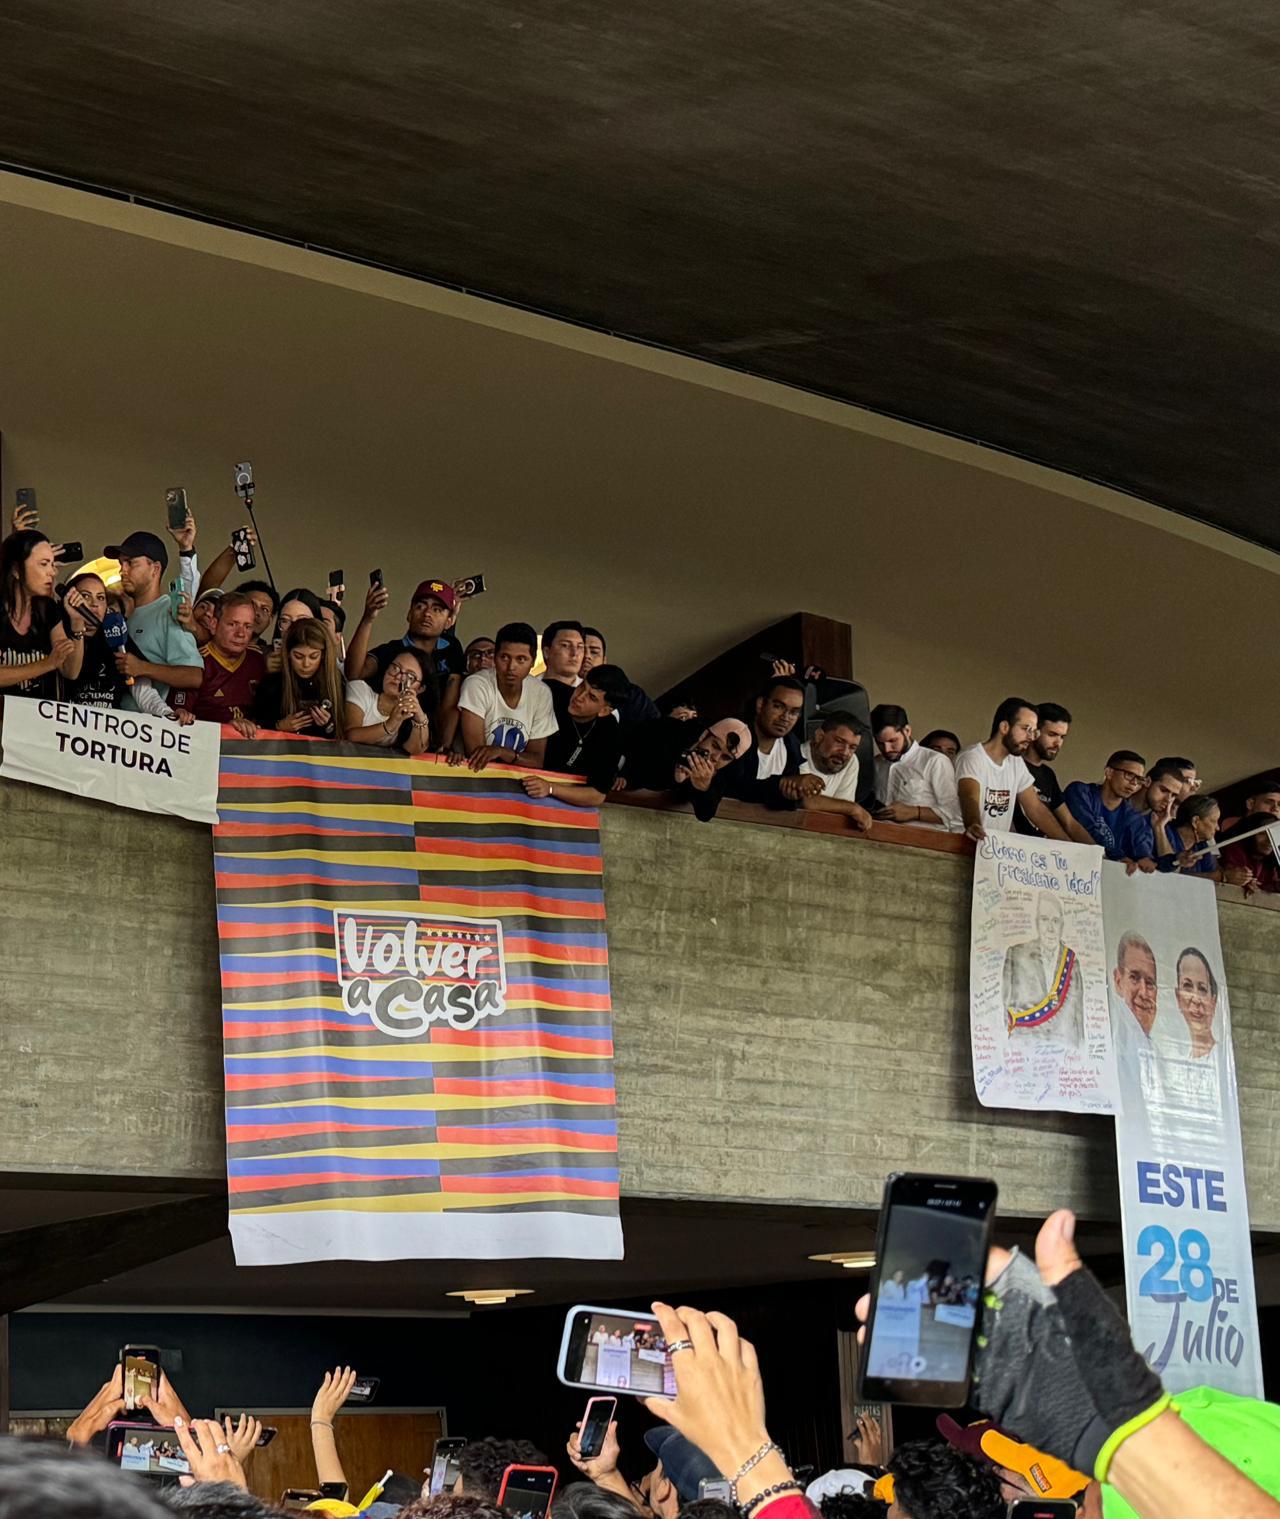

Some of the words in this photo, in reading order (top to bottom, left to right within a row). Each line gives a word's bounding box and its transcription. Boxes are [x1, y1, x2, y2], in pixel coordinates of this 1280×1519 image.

[38, 700, 153, 743] CENTROS
[161, 729, 192, 755] DE
[55, 731, 173, 778] TORTURA
[344, 917, 493, 980] Volver
[347, 978, 372, 1009] a
[375, 977, 500, 1030] Casa
[1137, 1161, 1227, 1212] ESTE
[1137, 1225, 1214, 1302] 28
[1213, 1278, 1240, 1303] DE
[1142, 1293, 1245, 1376] Julio
